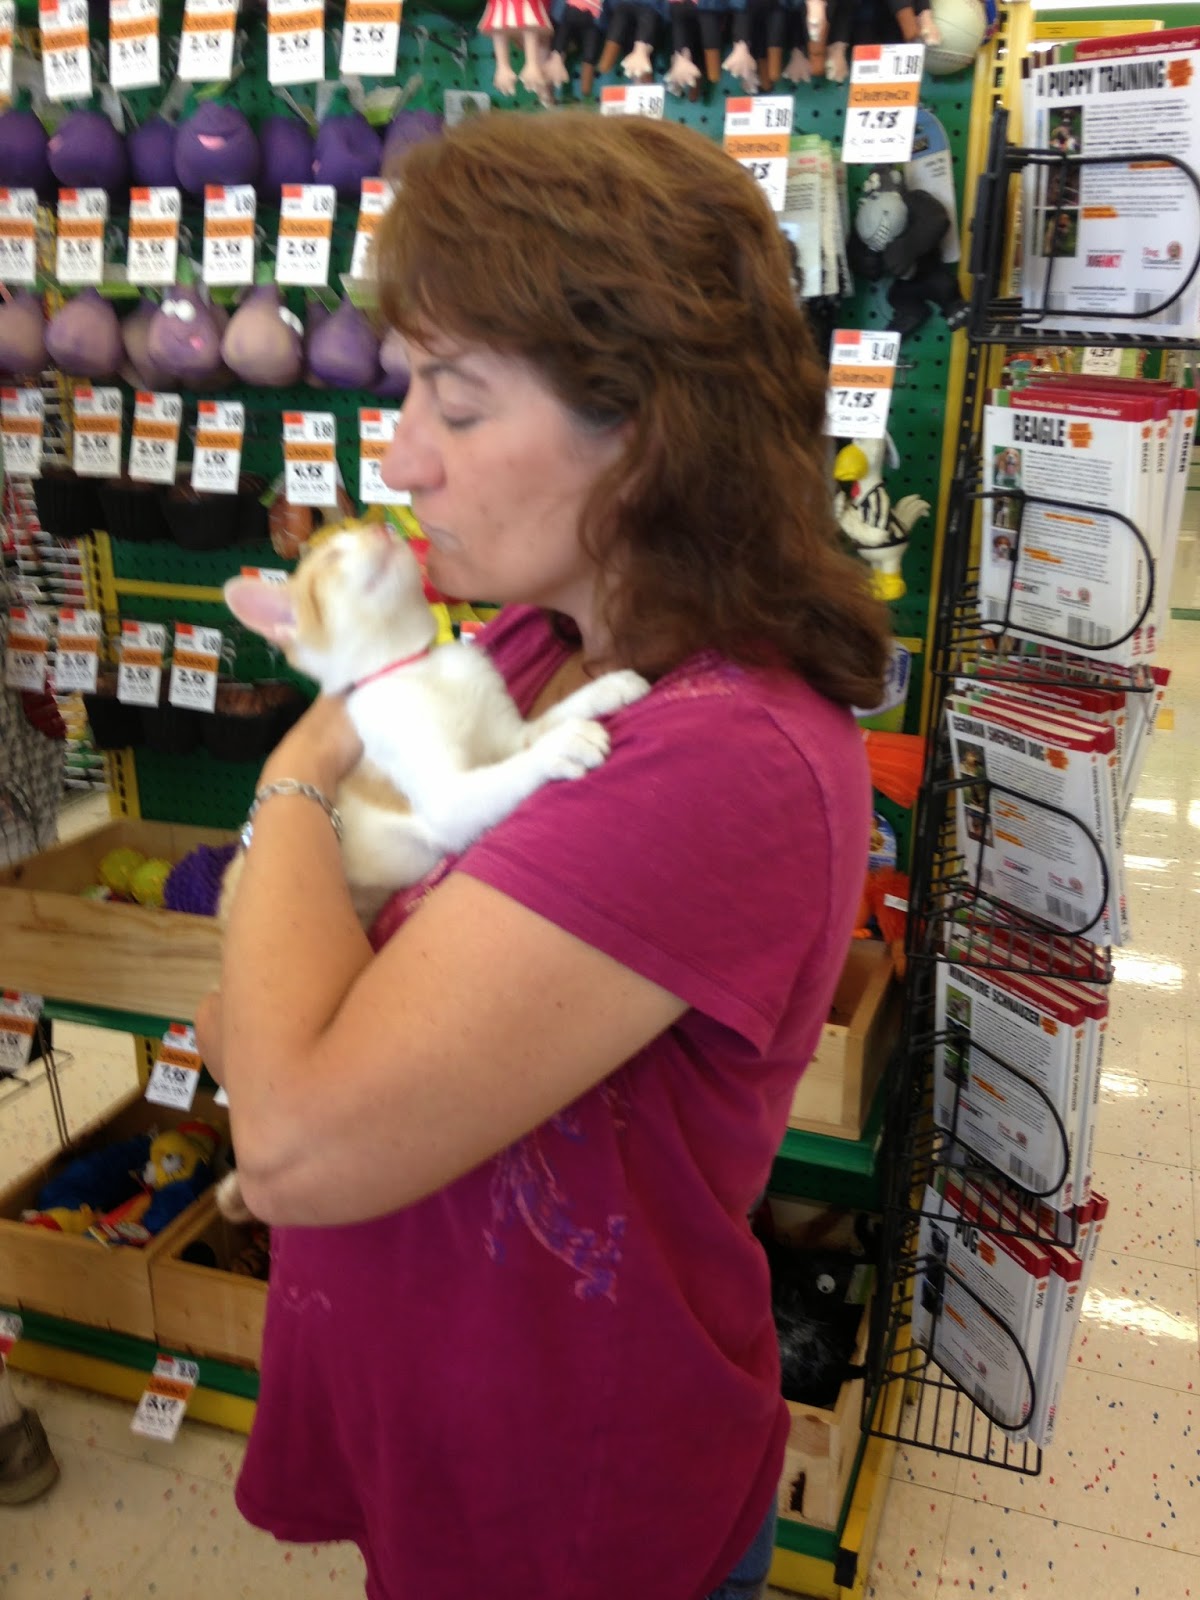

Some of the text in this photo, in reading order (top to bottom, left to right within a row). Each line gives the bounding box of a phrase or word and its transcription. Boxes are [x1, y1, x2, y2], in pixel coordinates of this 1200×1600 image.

[1048, 68, 1094, 97] PUPPY
[1098, 60, 1165, 93] TRAINING
[1013, 413, 1066, 448] BEAGLE
[949, 964, 1040, 1026] MINIATURE SCHNAUZER
[955, 1220, 980, 1256] PUG
